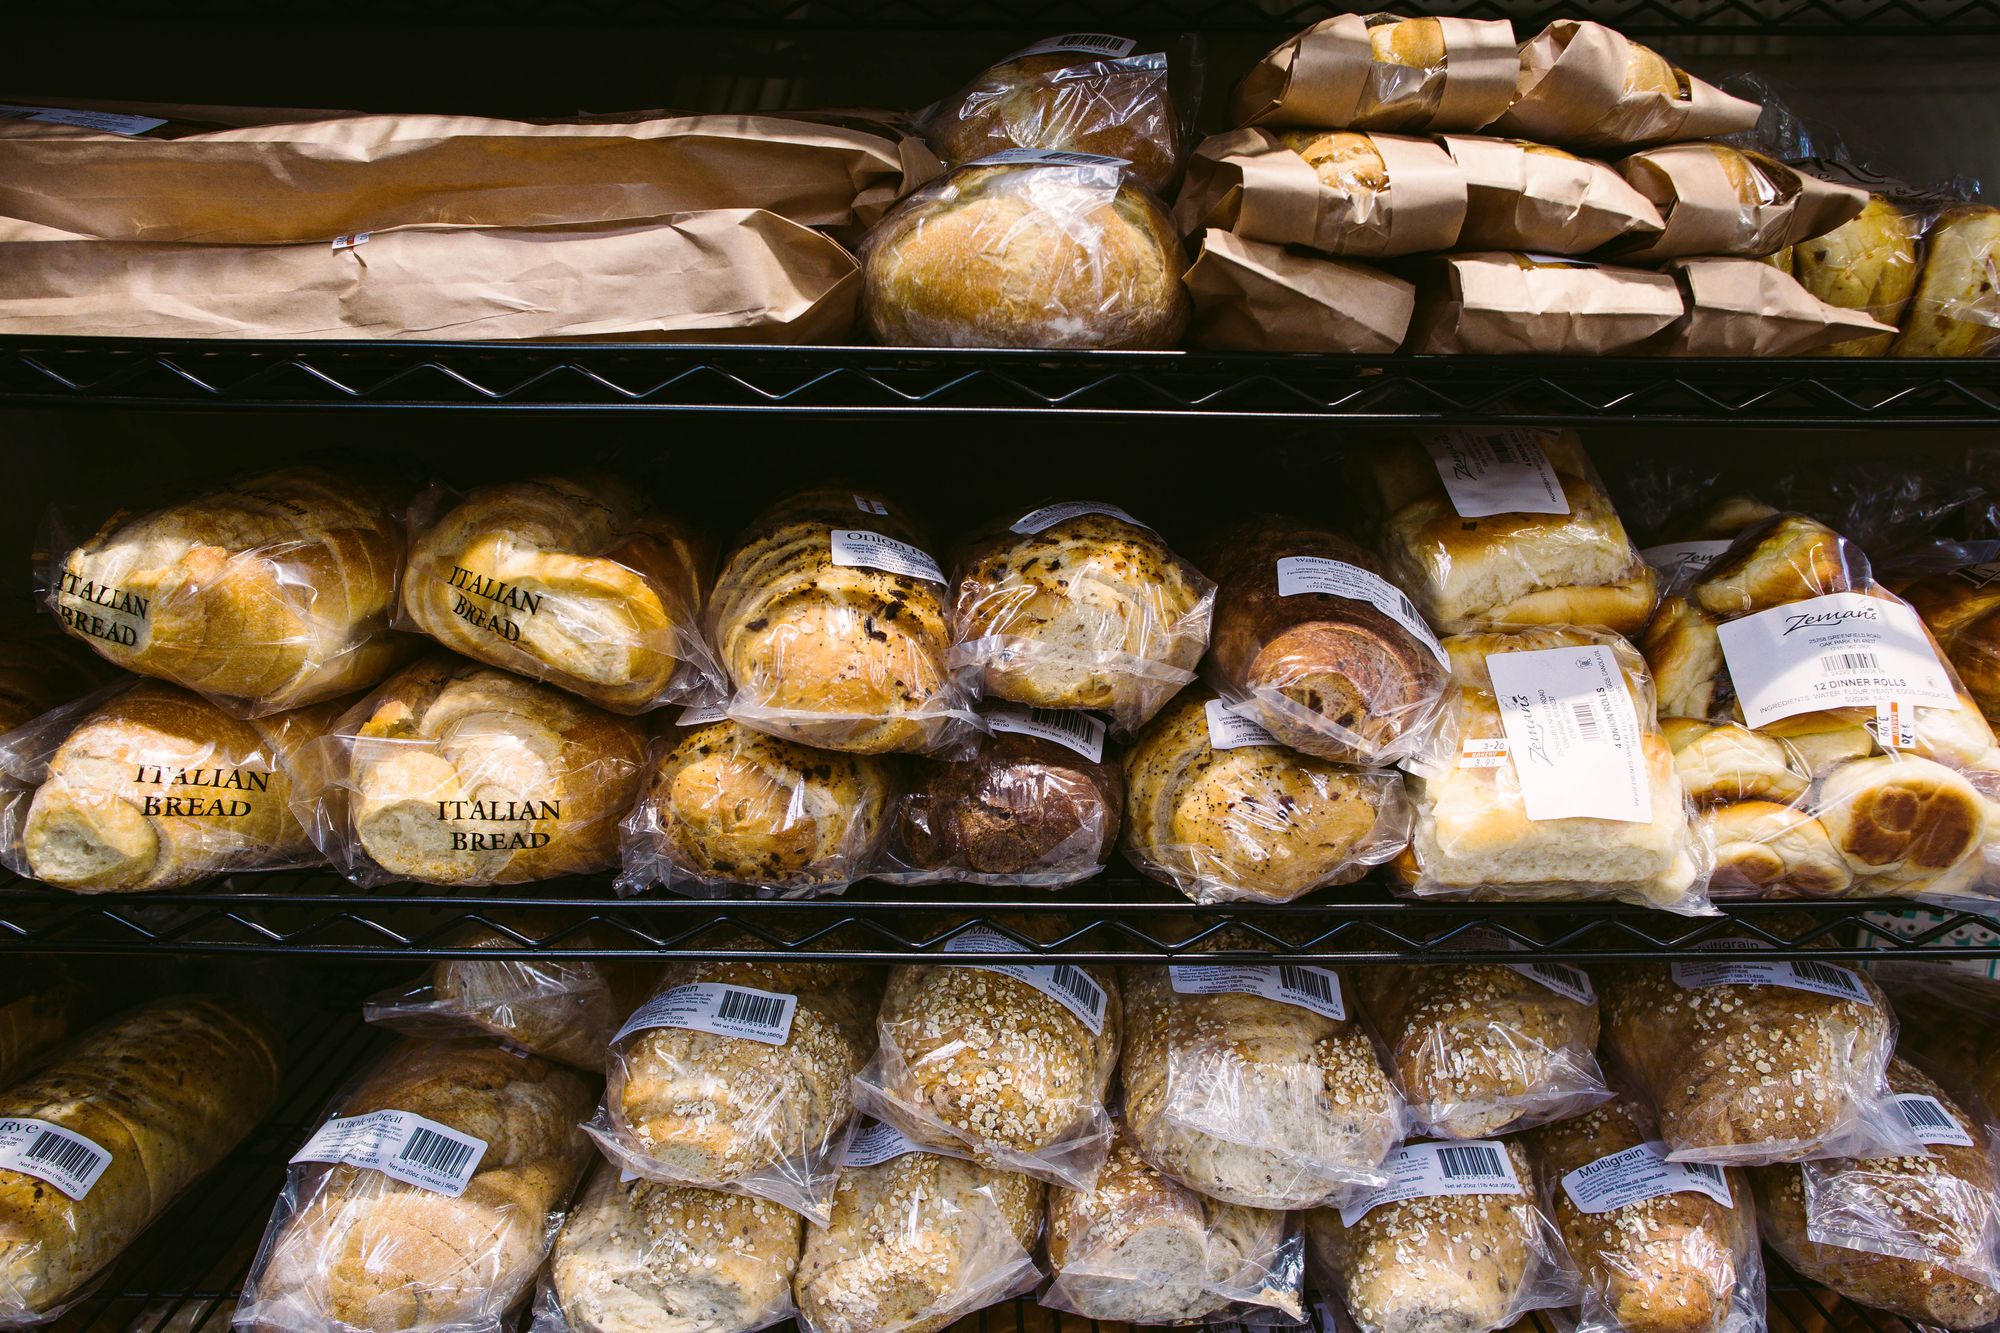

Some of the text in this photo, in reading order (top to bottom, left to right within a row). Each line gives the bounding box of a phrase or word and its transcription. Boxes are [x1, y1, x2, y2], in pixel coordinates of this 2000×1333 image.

[847, 532, 904, 550] Onion
[56, 571, 149, 619] ITALIAN
[447, 566, 543, 615] ITALIAN
[60, 605, 137, 646] BREAD
[453, 594, 520, 641] BREAD
[1597, 656, 1609, 675] CANOLA
[1814, 678, 1906, 691] 12 DINNER ROLLS
[1537, 688, 1548, 704] ROAD
[1596, 686, 1612, 711] ROLLS
[1607, 713, 1621, 740] ONION
[1484, 740, 1504, 749] 3-20
[1475, 759, 1495, 767] 3.99
[133, 764, 271, 792] ITALIAN
[141, 796, 252, 816] BREAD
[437, 800, 561, 820] ITALIAN
[450, 832, 550, 851] BREAD
[0, 1121, 39, 1134] Rye
[1578, 1148, 1645, 1178] Multigrain
[388, 1162, 398, 1170] Net
[445, 1183, 459, 1192] 560g
[66, 1183, 77, 1193] 453g
